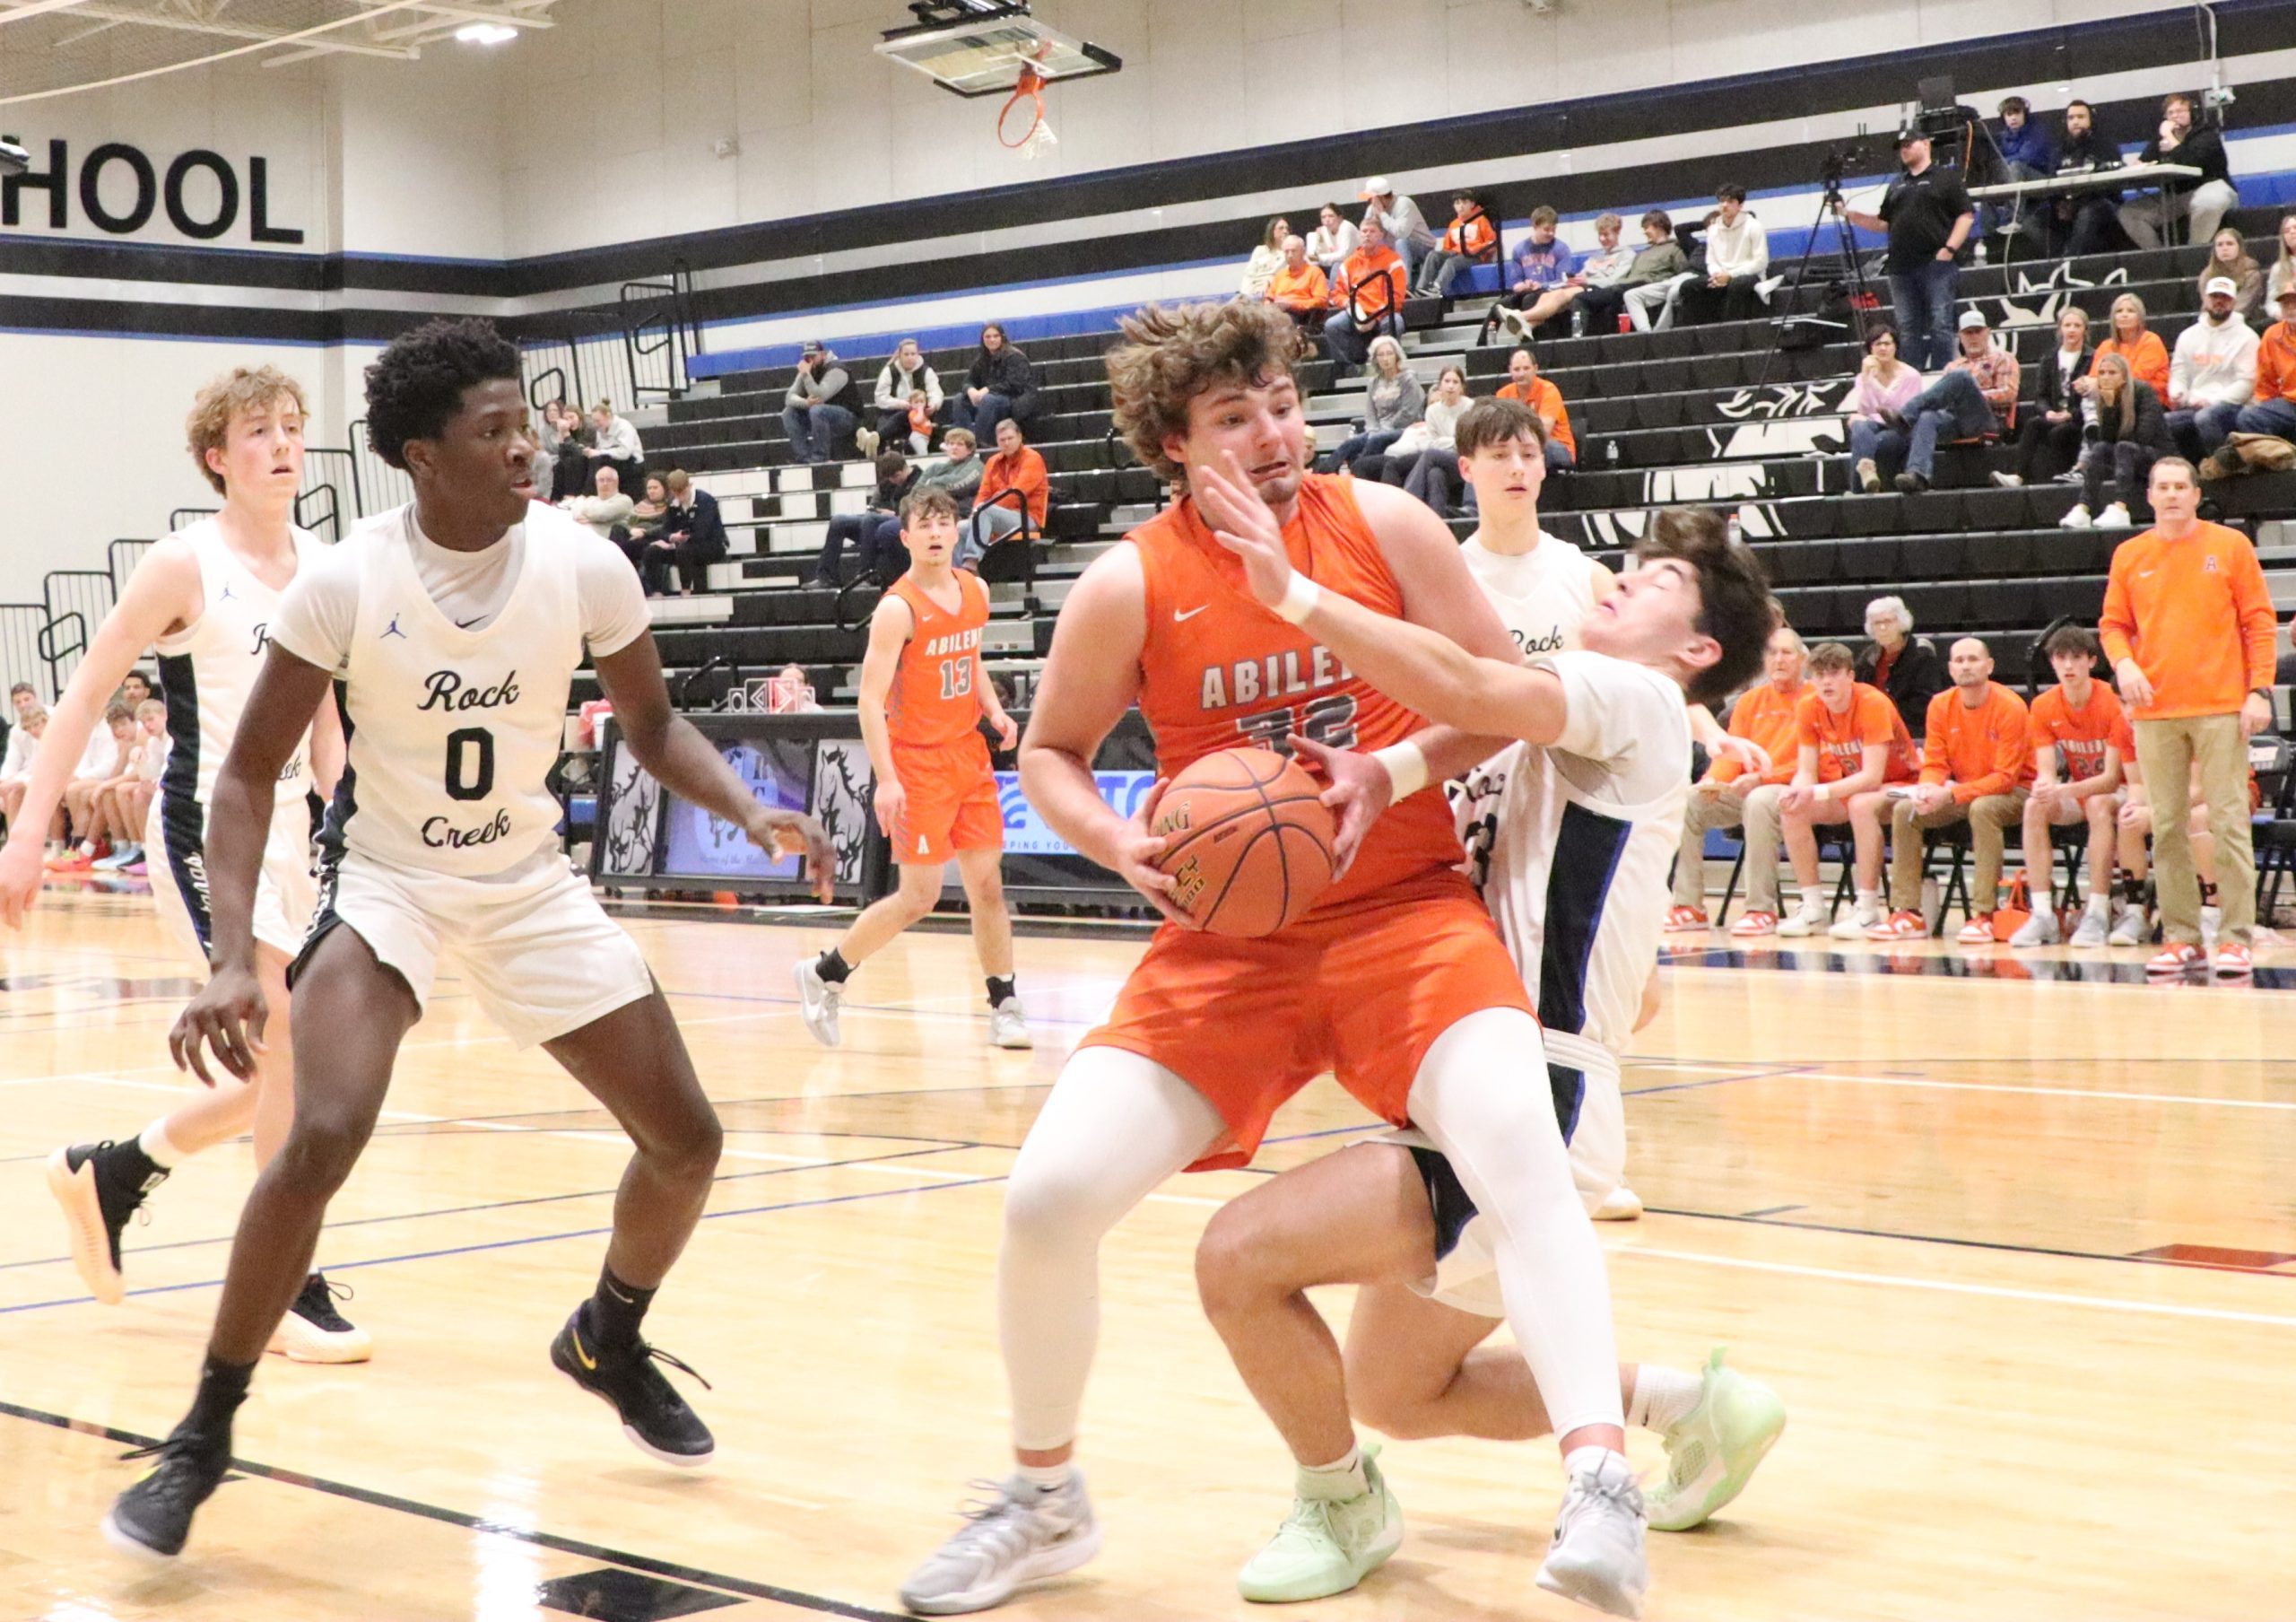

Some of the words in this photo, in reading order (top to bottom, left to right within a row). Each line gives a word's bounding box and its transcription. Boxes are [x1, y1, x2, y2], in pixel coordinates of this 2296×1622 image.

[417, 669, 519, 711] Rock
[939, 656, 972, 700] 13
[446, 728, 495, 801] 0
[422, 808, 511, 849] Creek
[918, 833, 930, 854] A
